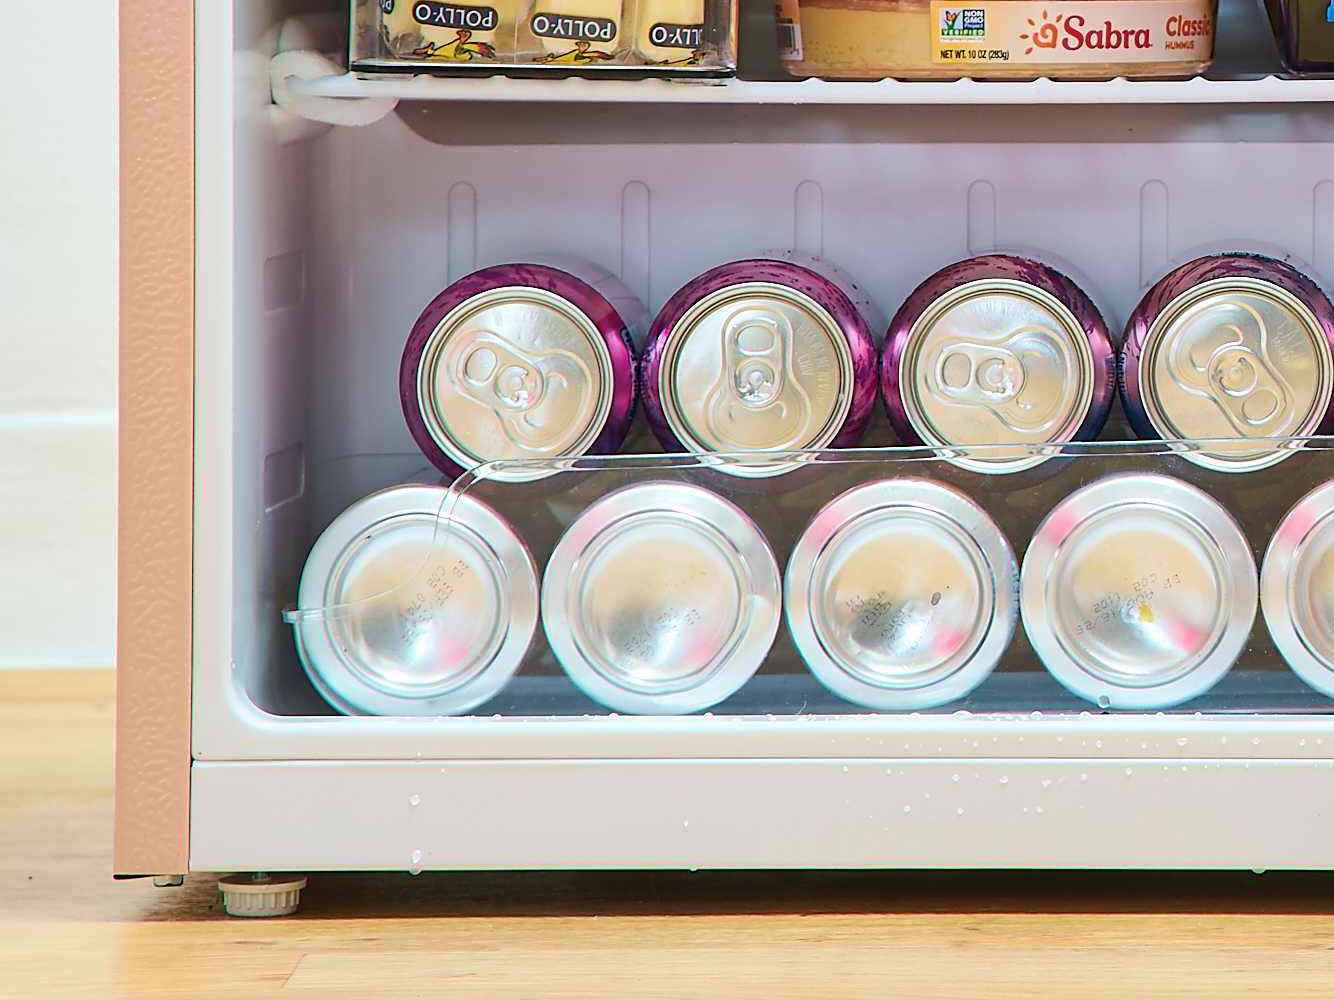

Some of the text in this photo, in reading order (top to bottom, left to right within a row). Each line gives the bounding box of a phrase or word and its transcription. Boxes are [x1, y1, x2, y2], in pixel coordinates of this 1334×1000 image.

[415, 3, 495, 28] POLLY-O
[532, 16, 613, 40] POLLY-O
[652, 24, 702, 46] LLY-O
[1061, 15, 1151, 50] Sabra
[940, 50, 953, 59] NET
[968, 50, 977, 59] 10
[978, 50, 987, 59] OZ
